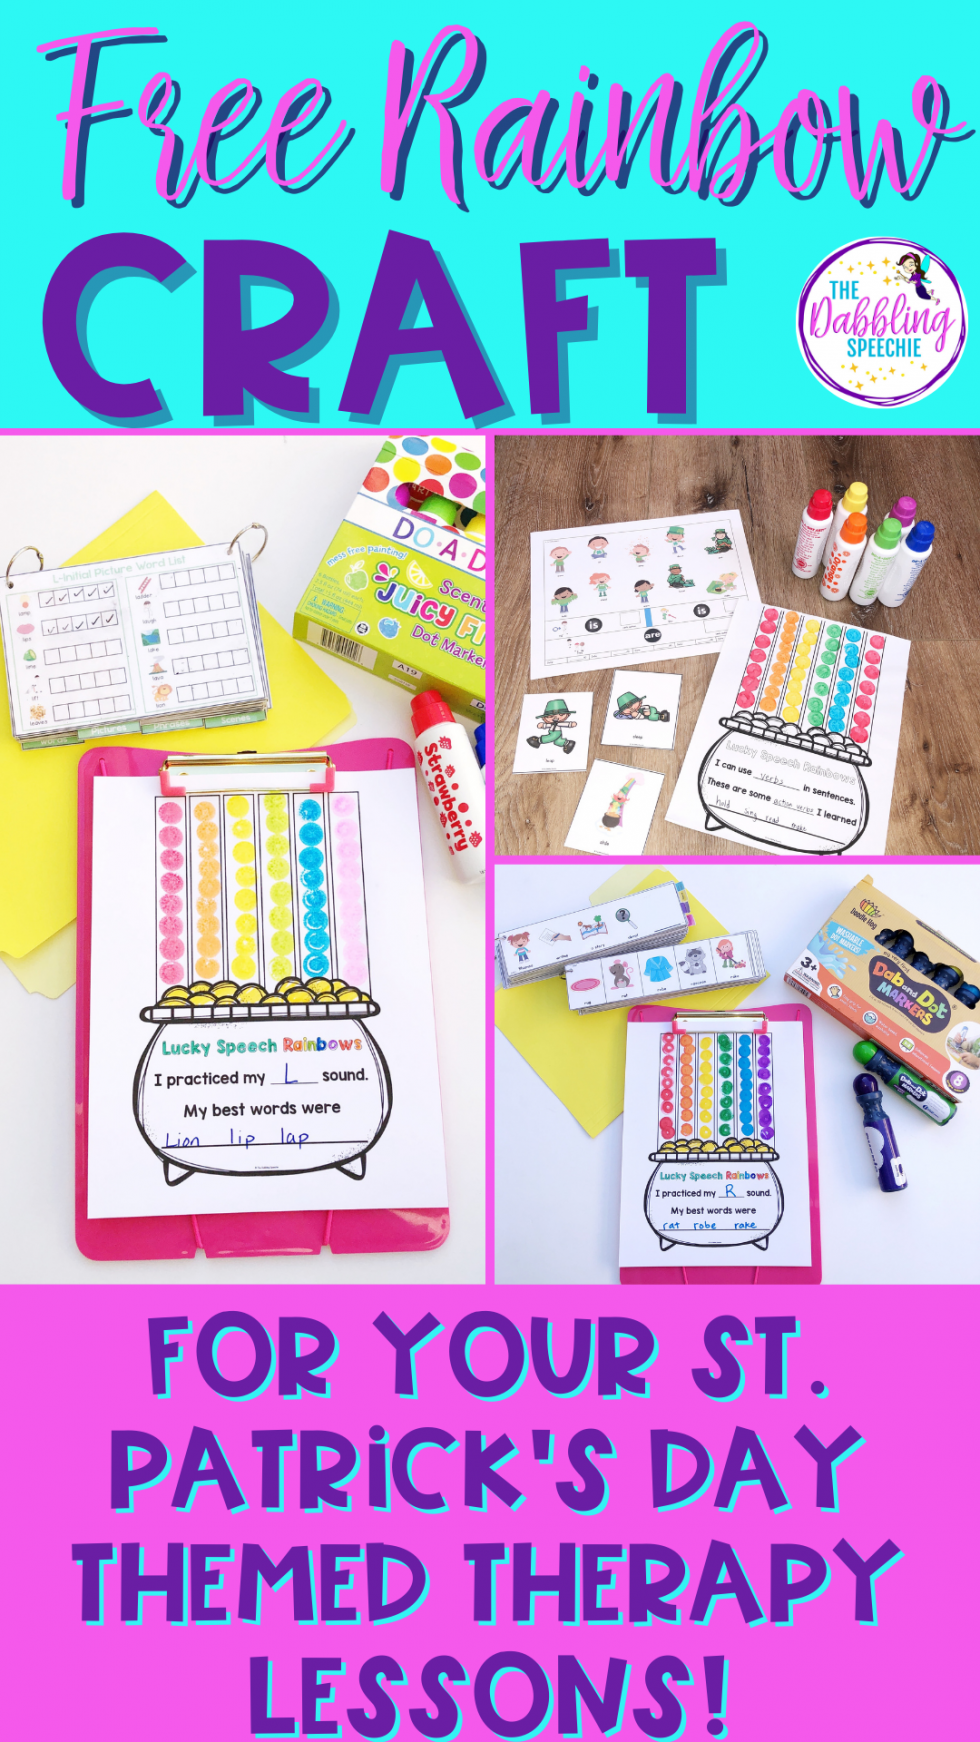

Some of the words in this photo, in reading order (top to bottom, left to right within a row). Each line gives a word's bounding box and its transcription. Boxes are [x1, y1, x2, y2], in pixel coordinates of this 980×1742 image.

[94, 563, 133, 577] Picture
[135, 558, 166, 571] Word
[168, 554, 187, 566] List
[326, 551, 347, 567] mess
[346, 545, 366, 556] free
[367, 544, 408, 560] painting!
[827, 556, 841, 584] Orange
[696, 606, 707, 615] is
[411, 624, 441, 647] Dot
[589, 621, 599, 630] is
[644, 631, 661, 640] are
[397, 663, 418, 676] A19
[91, 724, 127, 736] Pictures
[220, 714, 251, 725] Scenes
[726, 739, 758, 760] Lucky
[759, 749, 801, 771] Speech
[803, 760, 857, 786] Rainbows
[715, 758, 721, 767] I
[721, 762, 737, 772] can
[738, 767, 753, 776] use
[760, 772, 784, 785] verbs
[803, 784, 810, 792] in
[812, 788, 856, 806] sentences.
[424, 742, 468, 852] Strawberry
[707, 776, 731, 790] These
[732, 784, 748, 795] are
[748, 789, 772, 802] some
[816, 808, 823, 817] I
[823, 810, 858, 827] learned
[849, 907, 868, 923] Doodle
[866, 918, 878, 931] Hog
[830, 932, 840, 942] DOT
[838, 937, 862, 954] MARKERS!
[835, 926, 865, 948] WASHABLE
[800, 956, 818, 971] 3+
[891, 954, 901, 965] very
[872, 961, 905, 987] Dab
[901, 984, 919, 998] and
[916, 989, 948, 1019] Dot
[876, 981, 933, 1026] MARKERS
[162, 1040, 211, 1058] Lucky
[216, 1038, 278, 1057] Speech
[283, 1036, 363, 1053] Rainbows
[154, 1073, 162, 1087] I
[166, 1070, 239, 1089] practiced
[243, 1073, 266, 1087] my
[284, 1062, 299, 1085] L
[322, 1067, 369, 1082] sound.
[953, 1074, 964, 1087] 8
[183, 1104, 208, 1120] My
[212, 1102, 246, 1117] best
[250, 1101, 298, 1116] words
[301, 1103, 342, 1114] were
[230, 1128, 256, 1150] lip
[281, 1127, 309, 1150] lap
[660, 1171, 687, 1182] Lucky
[689, 1171, 723, 1182] Speech
[725, 1170, 770, 1180] Rainbows
[655, 1189, 660, 1198] I
[661, 1189, 702, 1199] practiced
[703, 1190, 716, 1199] my
[725, 1183, 737, 1198] R
[746, 1188, 772, 1197] sound.
[670, 1206, 684, 1216] My
[686, 1206, 704, 1215] best
[706, 1206, 733, 1215] words
[734, 1207, 757, 1215] were
[662, 1221, 681, 1230] rat
[693, 1220, 717, 1230] robe
[734, 1221, 758, 1230] rake
